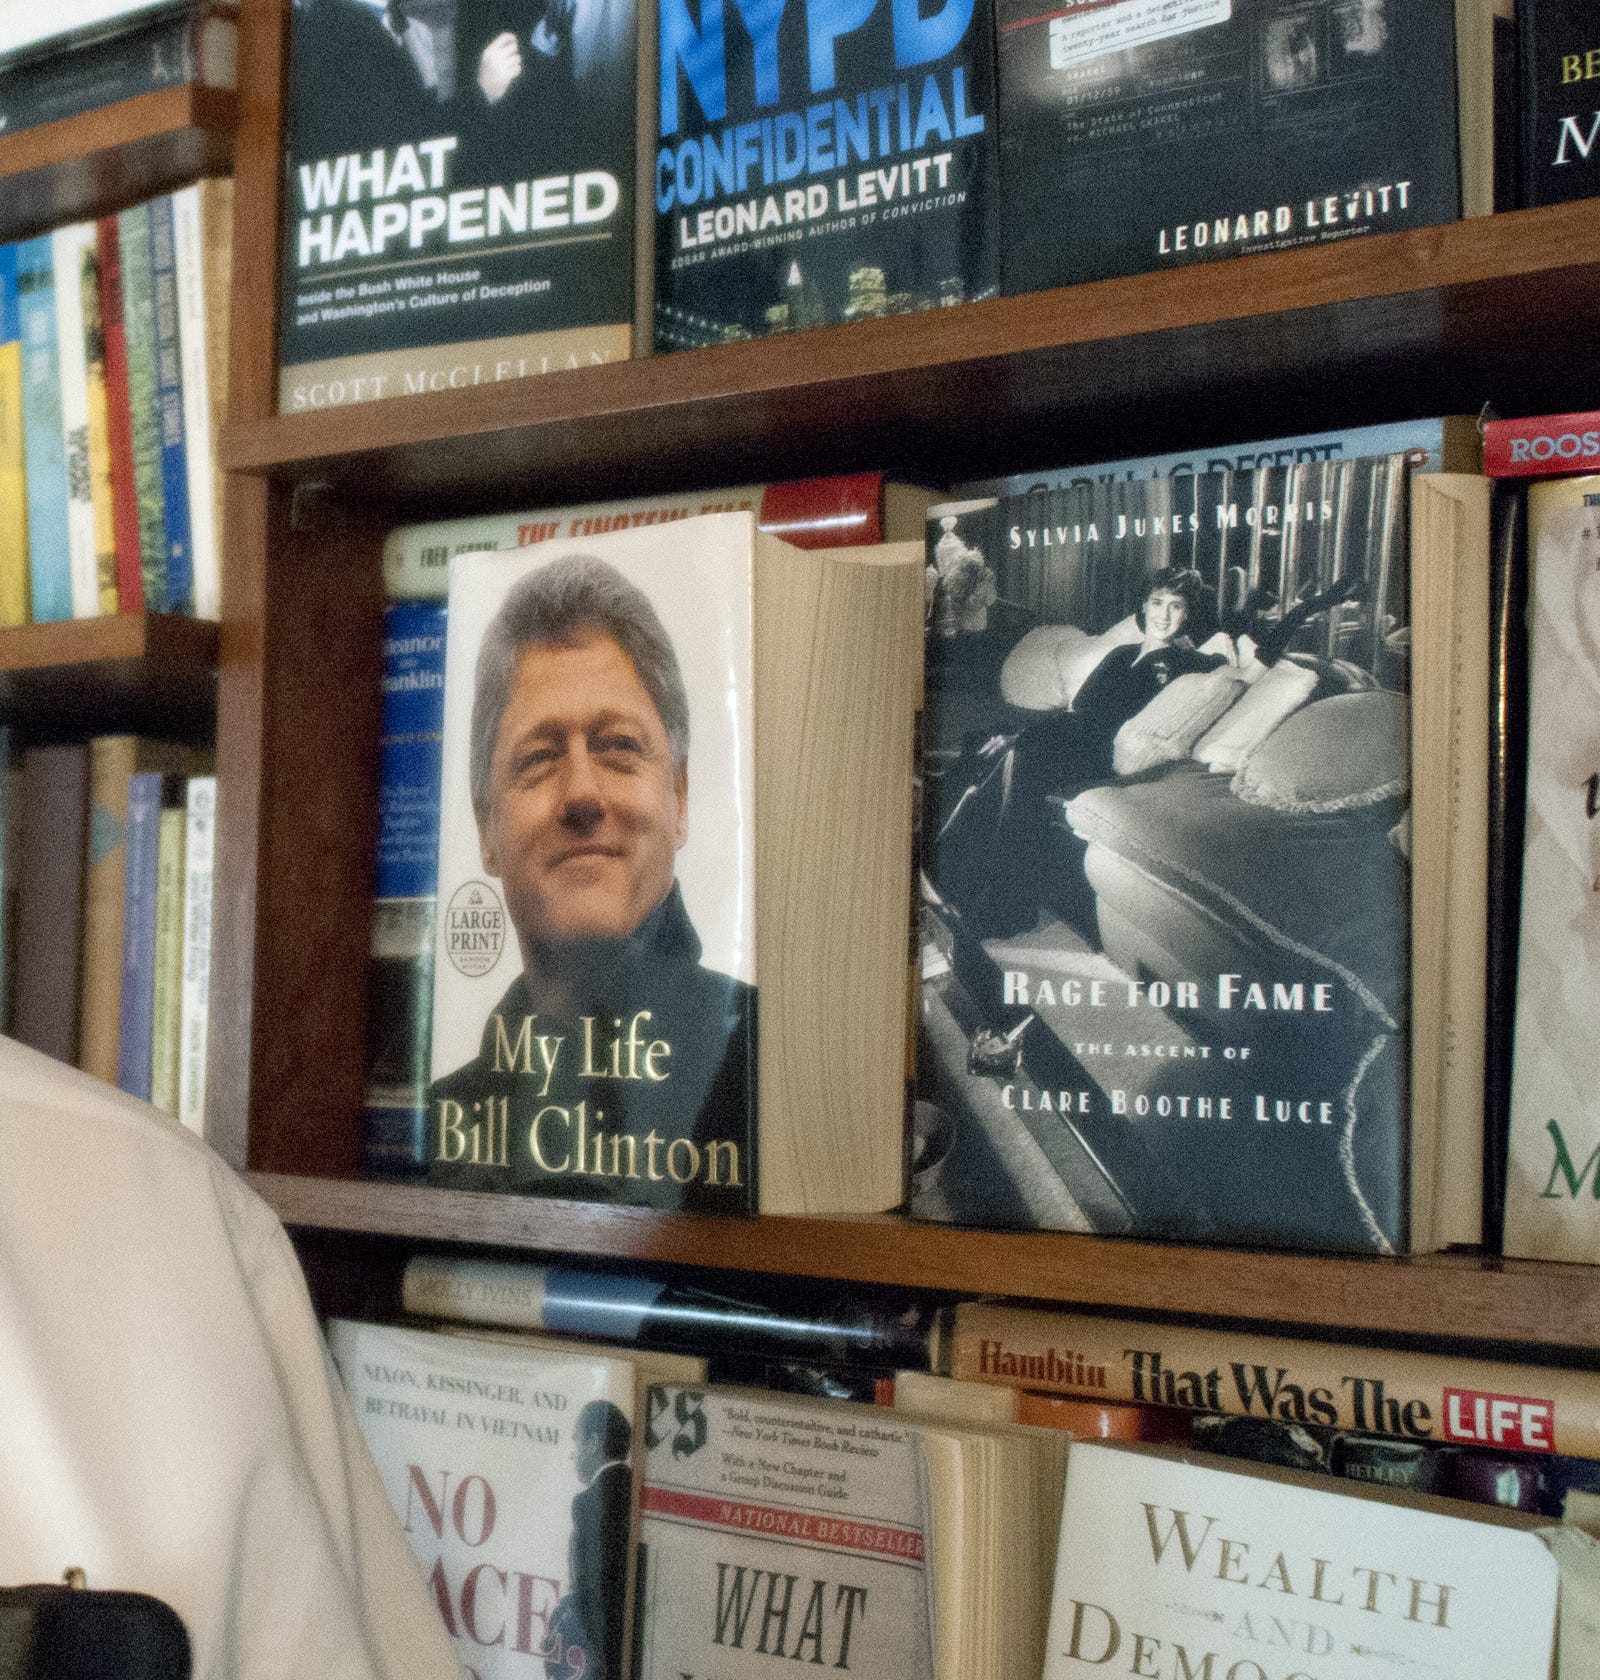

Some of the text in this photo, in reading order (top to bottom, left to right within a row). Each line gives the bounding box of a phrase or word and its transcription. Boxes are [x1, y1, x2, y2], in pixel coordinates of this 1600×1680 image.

[1062, 29, 1121, 53] twenty-year
[658, 0, 977, 137] NYPD
[1561, 49, 1600, 84] BE
[655, 67, 985, 213] CONFIDENTIAL
[300, 136, 458, 211] WHAT
[298, 170, 620, 266] HAPPENED
[681, 153, 953, 249] LEONARD LEVITT
[808, 218, 857, 237] AUTHOR
[862, 213, 877, 227] OF
[882, 193, 967, 221] CONVICTION
[1159, 181, 1411, 254] LEONARD LEVITT
[298, 279, 551, 325] and Washington's Culture of Deception
[335, 286, 355, 300] the
[358, 280, 392, 297] Bush
[395, 275, 433, 291] White
[437, 270, 482, 284] House
[292, 375, 387, 410] SCOTT
[1510, 431, 1600, 462] ROOS
[1009, 500, 1334, 550] SYLVIA JUKES MORRIS
[450, 911, 501, 929] LARGE
[450, 932, 501, 951] PRINT
[1003, 971, 1334, 1012] RAGE FOR FAME
[491, 1010, 673, 1097] My Life
[1074, 1042, 1251, 1060] THE ASCENT OF
[1002, 1084, 1333, 1125] CLARE BOOTHE LUCE
[436, 1095, 744, 1187] Bill Clinton
[426, 1373, 525, 1406] KISSINGER,
[532, 1391, 568, 1412] AND
[1122, 1349, 1223, 1412] That
[1228, 1362, 1338, 1428] Was
[1341, 1376, 1433, 1439] The
[1448, 1393, 1550, 1449] LIFE
[364, 1397, 560, 1446] BETRAYAL IN VIETNAM
[756, 1427, 779, 1443] York
[782, 1432, 812, 1448] Times
[814, 1437, 839, 1452] Book
[841, 1440, 880, 1458] Review
[837, 1424, 856, 1438] and
[721, 1452, 746, 1467] With
[758, 1458, 780, 1472] New
[783, 1461, 825, 1479] Chapter
[827, 1469, 847, 1482] and
[729, 1470, 760, 1487] Group
[762, 1475, 815, 1495] Discussion
[817, 1484, 849, 1500] Guide
[403, 1464, 497, 1548] NO
[721, 1504, 809, 1536] NATIONAL
[1139, 1502, 1457, 1628] WEALTH
[428, 1556, 587, 1680] ACE,
[712, 1562, 868, 1669] WHAT
[1232, 1609, 1336, 1658] AND
